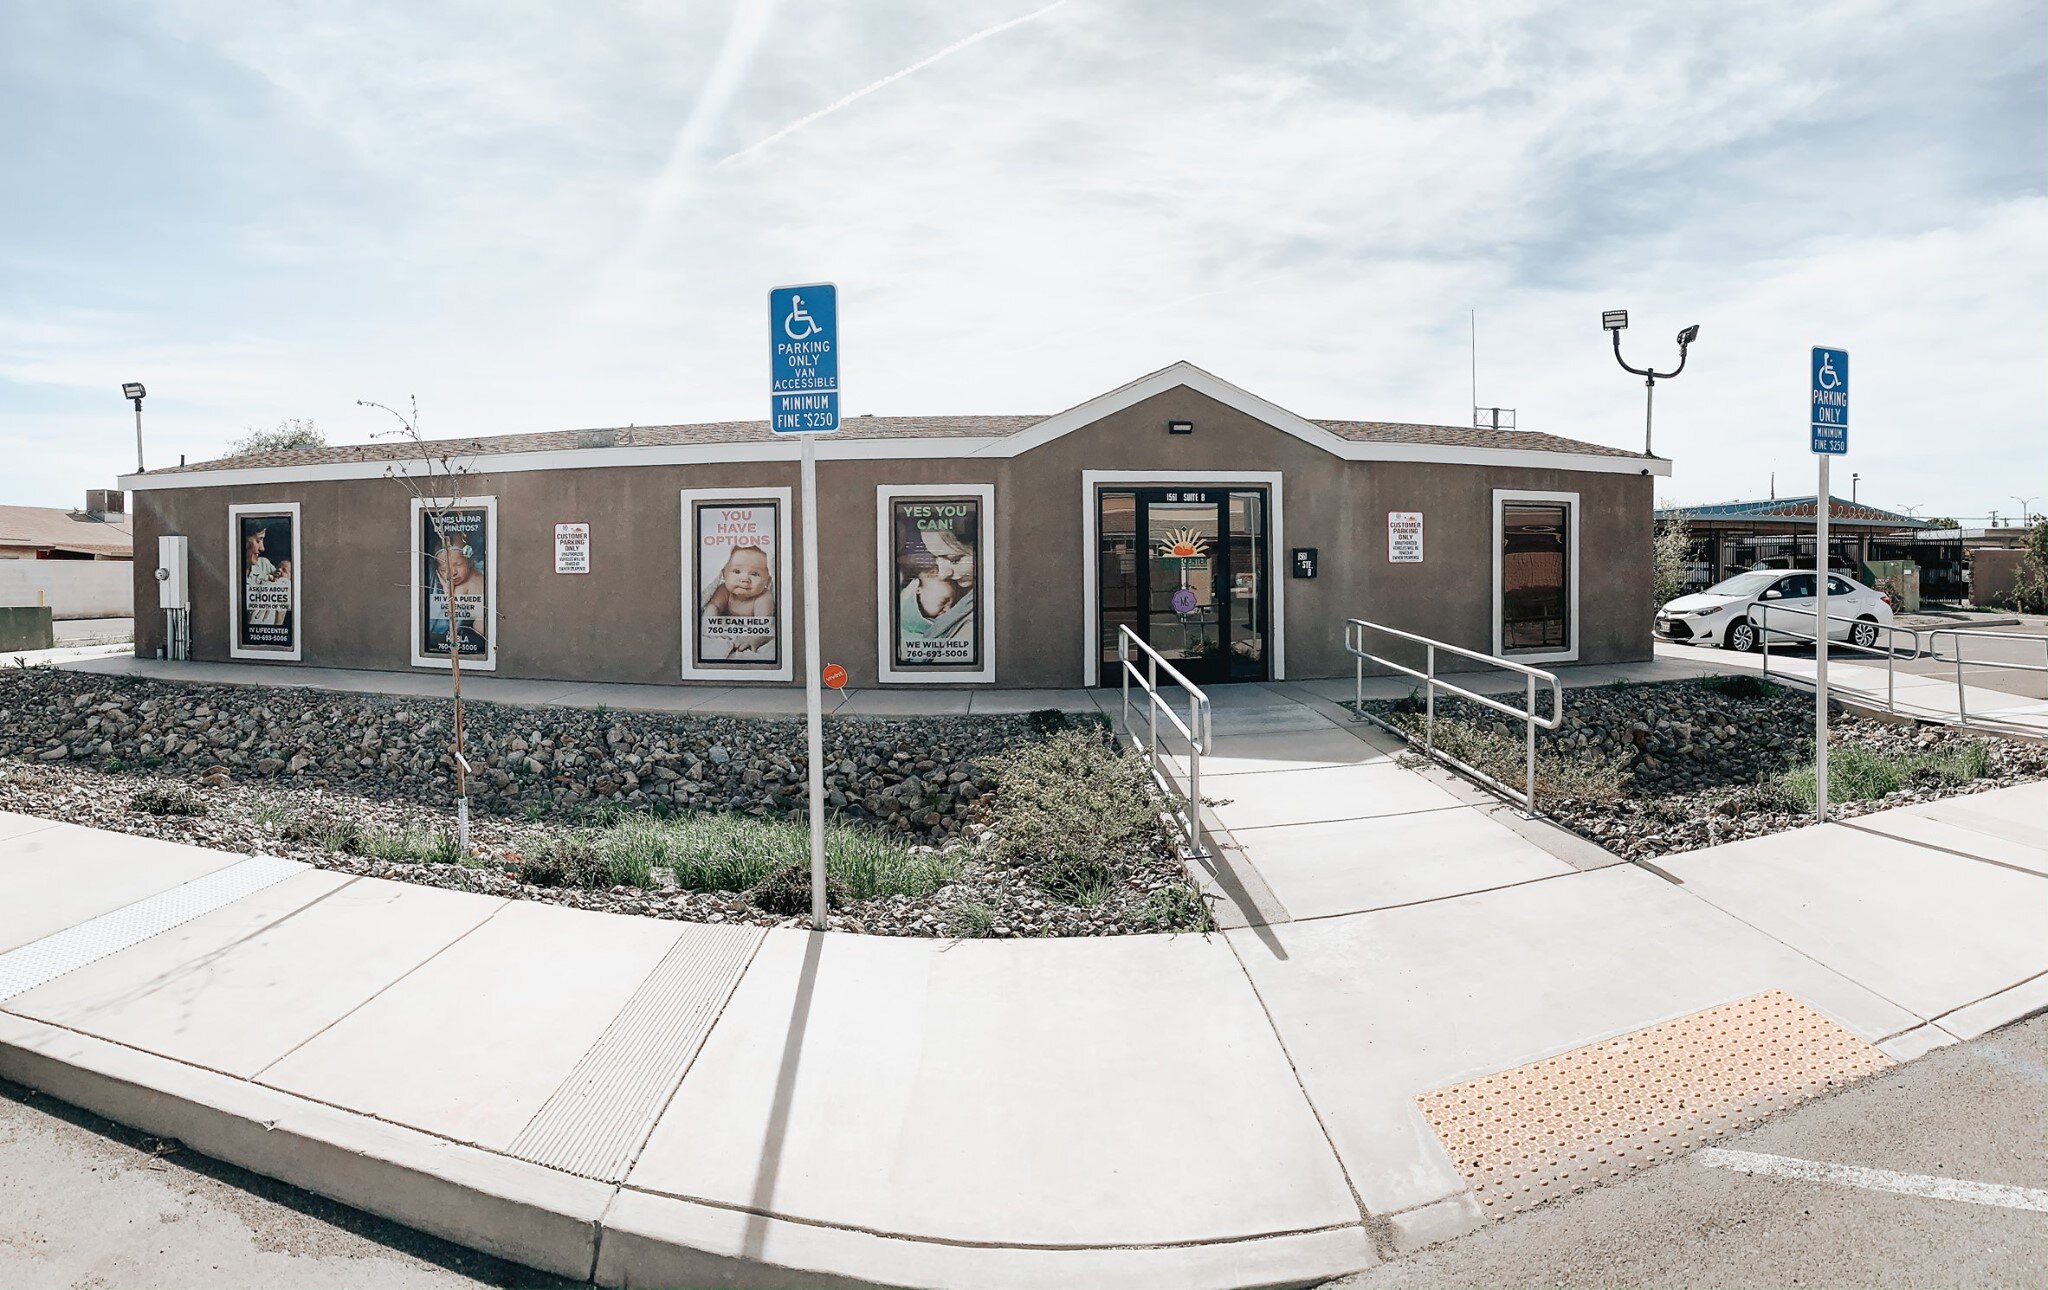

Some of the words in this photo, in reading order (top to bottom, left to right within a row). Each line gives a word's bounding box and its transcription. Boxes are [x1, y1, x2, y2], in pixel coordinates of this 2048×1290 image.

[778, 341, 830, 354] PARKING
[788, 354, 820, 367] ONLY
[795, 367, 815, 378] VAN
[774, 377, 835, 390] ACCESSIBLE
[782, 395, 829, 411] MINIMUM
[1813, 389, 1847, 407] PARKING
[778, 413, 800, 428] FINE
[806, 412, 833, 428] $250
[1819, 407, 1840, 422] ONLY
[1817, 428, 1842, 438] MINIMUM
[1814, 439, 1827, 450] FINE
[1829, 440, 1845, 451] $250
[1166, 493, 1178, 501] 1561
[1183, 493, 1199, 502] SUITE
[721, 510, 752, 521] YOU
[903, 506, 932, 517] YES
[935, 505, 967, 517] YOU
[444, 524, 479, 532] MINUTOS?
[717, 523, 757, 534] HAVE
[916, 518, 953, 530] CAN!
[703, 535, 771, 546] OPTIONS
[249, 594, 288, 603] CHOICES
[442, 595, 460, 603] VA
[459, 595, 482, 603] PUEDE
[725, 618, 744, 626] CAN
[747, 618, 769, 626] HELP
[255, 627, 289, 635] LIFECENTER
[708, 626, 770, 635] 760-693-5006
[445, 635, 470, 643] HBLA
[907, 650, 968, 658] 760-693-5006
